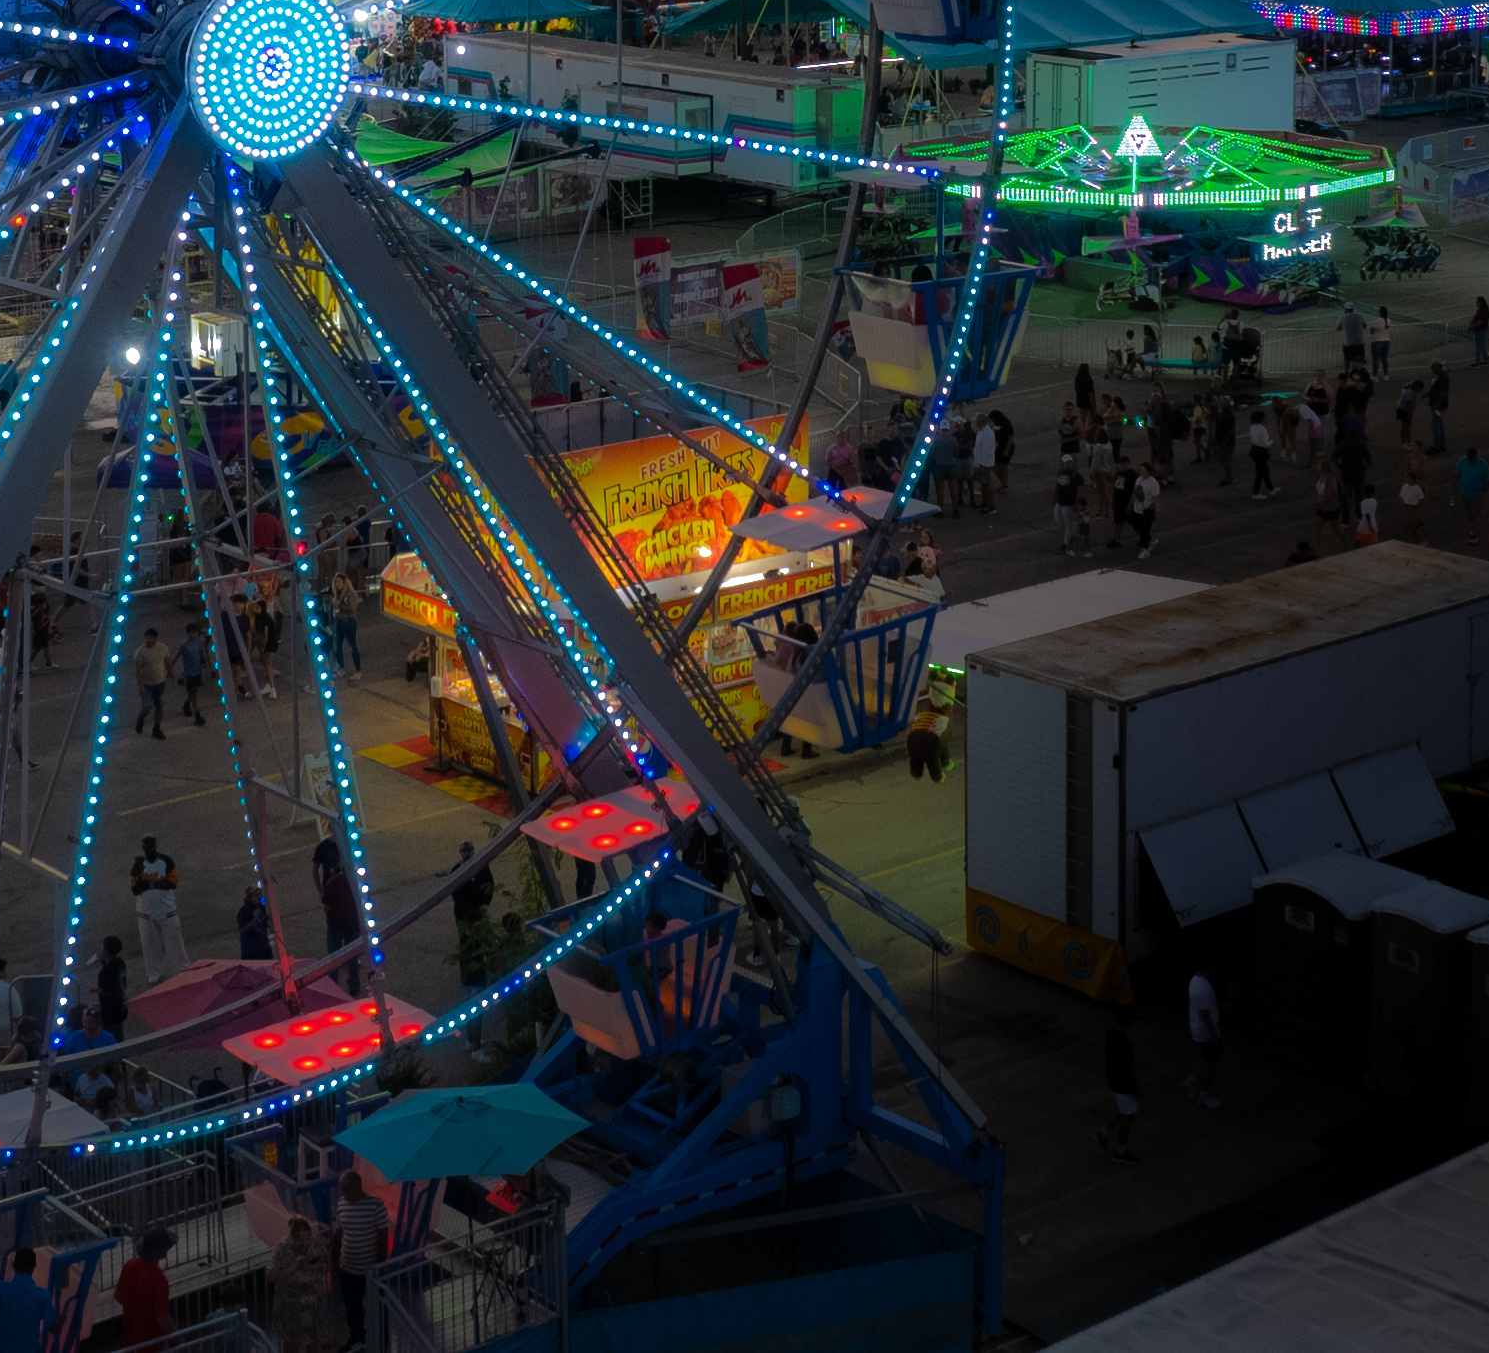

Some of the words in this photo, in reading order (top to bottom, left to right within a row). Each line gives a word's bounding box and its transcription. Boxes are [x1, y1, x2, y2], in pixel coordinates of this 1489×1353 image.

[638, 447, 689, 481] FRESH
[603, 468, 690, 525] FRENCH
[635, 519, 715, 564] CHICKEN
[644, 538, 713, 575] WINGS
[384, 587, 438, 623] FRENCH
[719, 581, 788, 615] FRENCH
[1287, 903, 1310, 923] SOS
[1391, 945, 1415, 965] SOS
